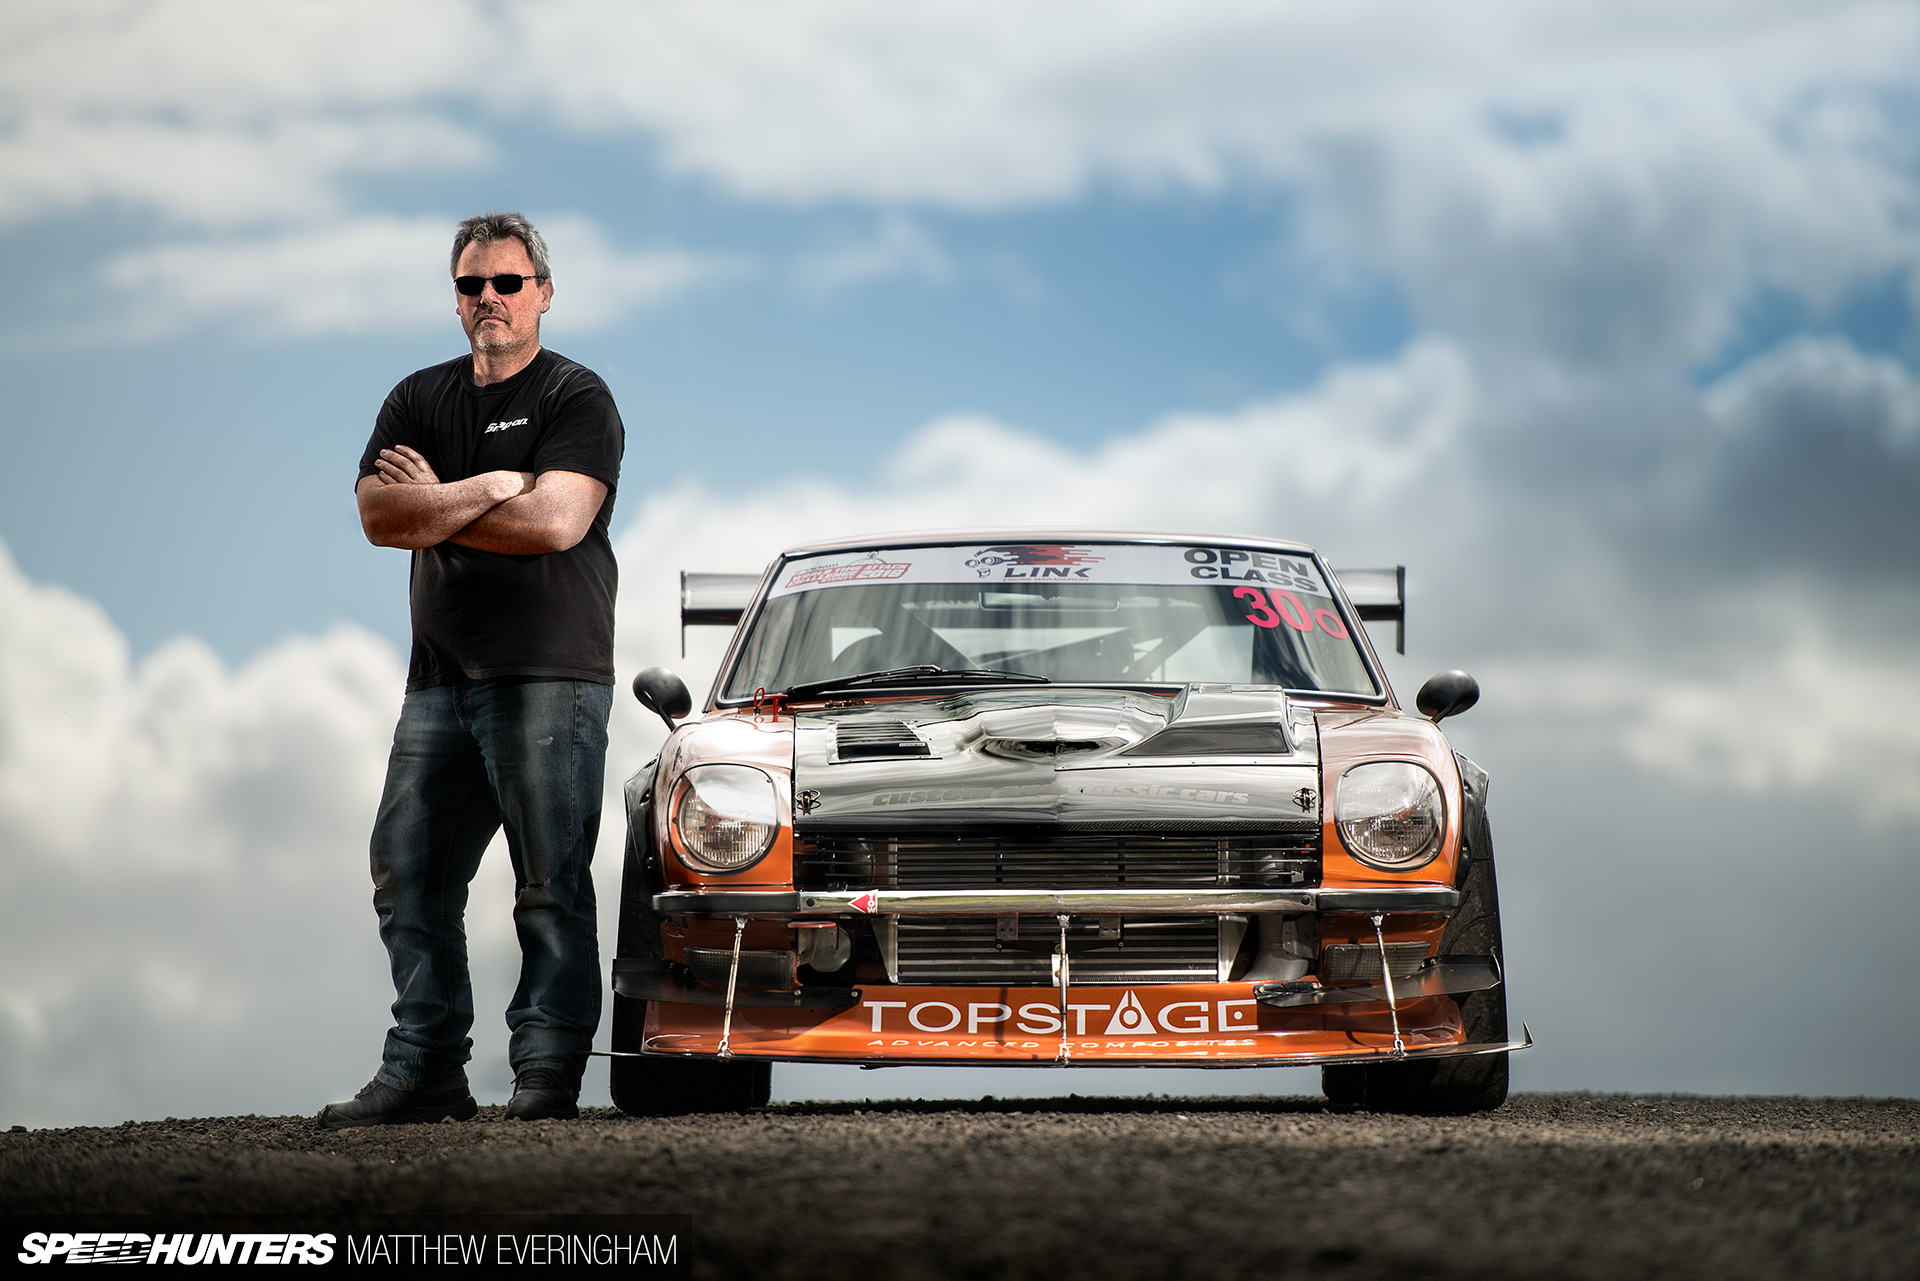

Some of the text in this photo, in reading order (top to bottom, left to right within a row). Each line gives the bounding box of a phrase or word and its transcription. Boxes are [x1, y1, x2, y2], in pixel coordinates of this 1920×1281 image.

[865, 563, 908, 571] ATTACK
[1184, 548, 1309, 577] OPEN
[1004, 567, 1092, 578] LINK
[1191, 566, 1319, 592] CLASS
[873, 787, 993, 806] custom
[1180, 788, 1248, 804] cars
[862, 990, 1259, 1035] TOPSTAGE
[867, 1039, 1040, 1048] ADVANCED
